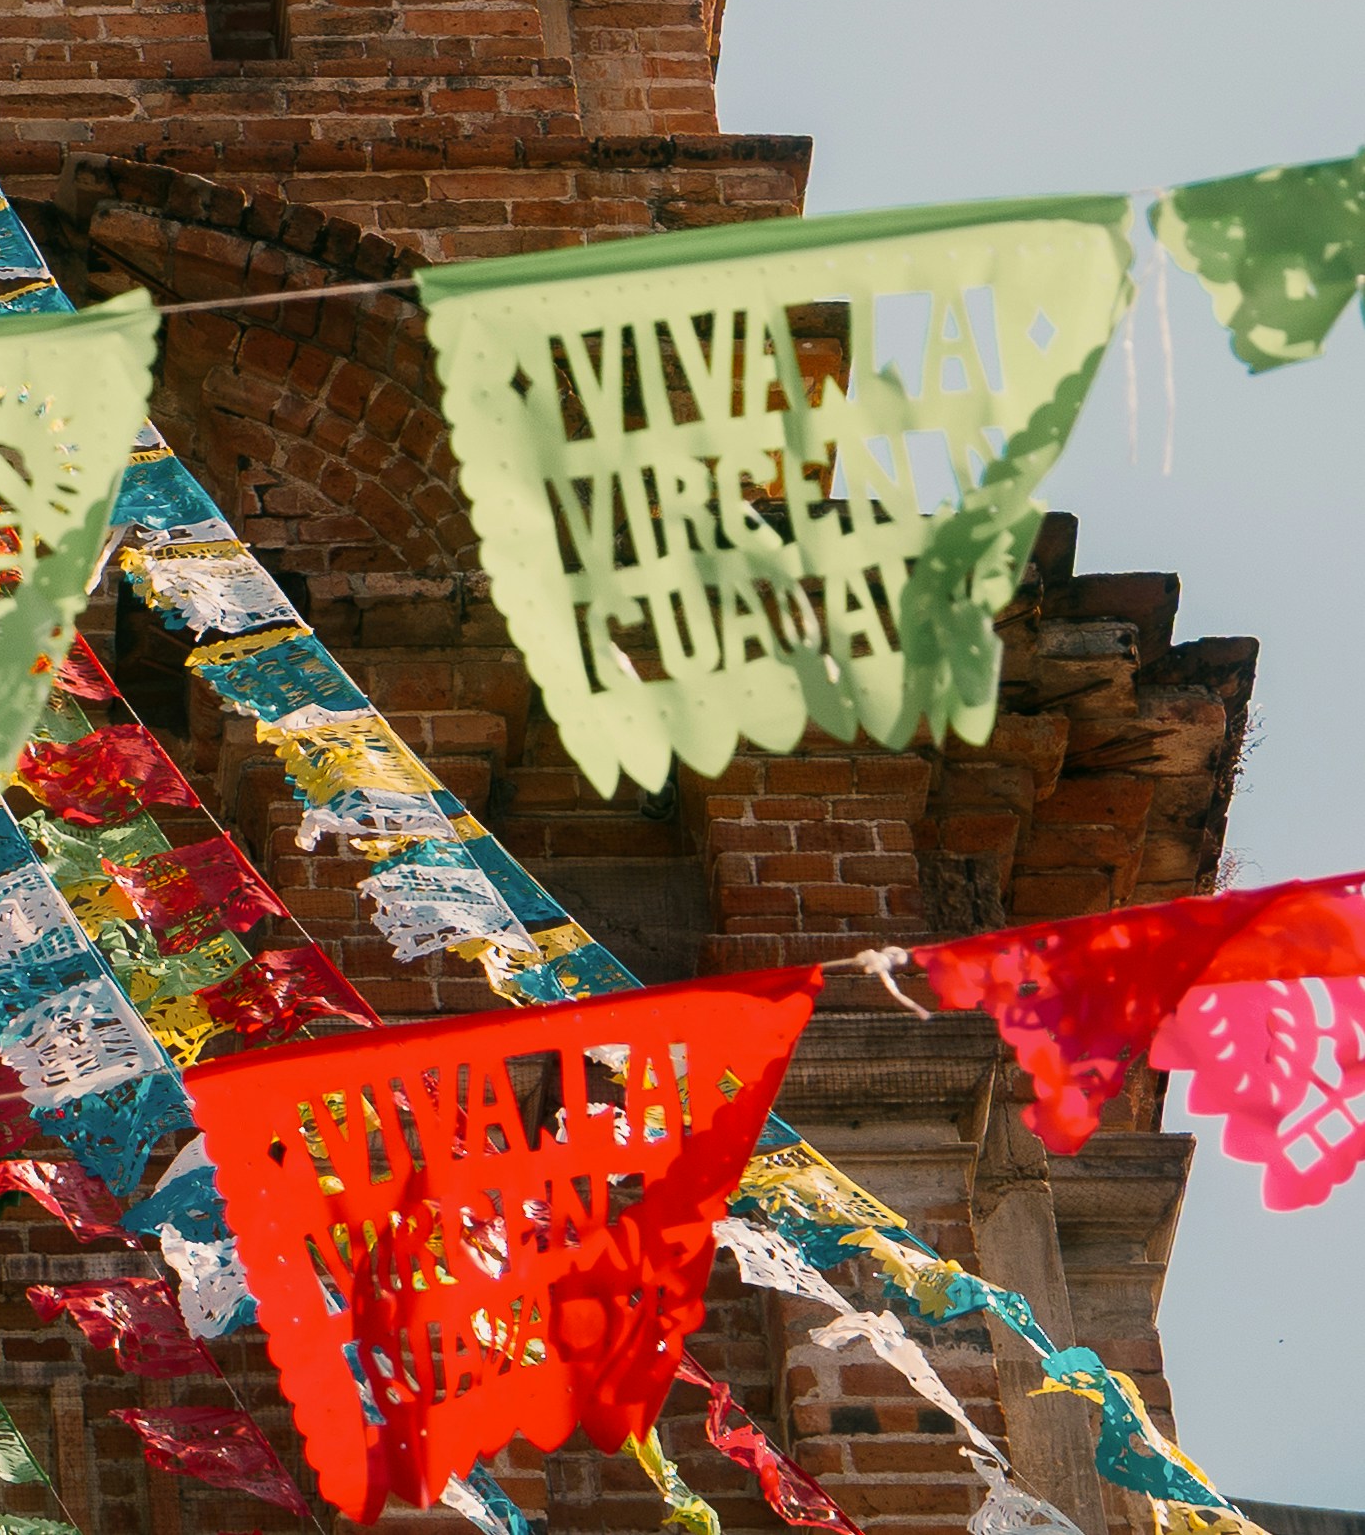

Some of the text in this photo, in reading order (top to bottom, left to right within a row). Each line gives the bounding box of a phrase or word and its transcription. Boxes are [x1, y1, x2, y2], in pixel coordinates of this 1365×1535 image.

[559, 286, 993, 444] VIVA LA
[307, 1040, 689, 1192] VIVA LA
